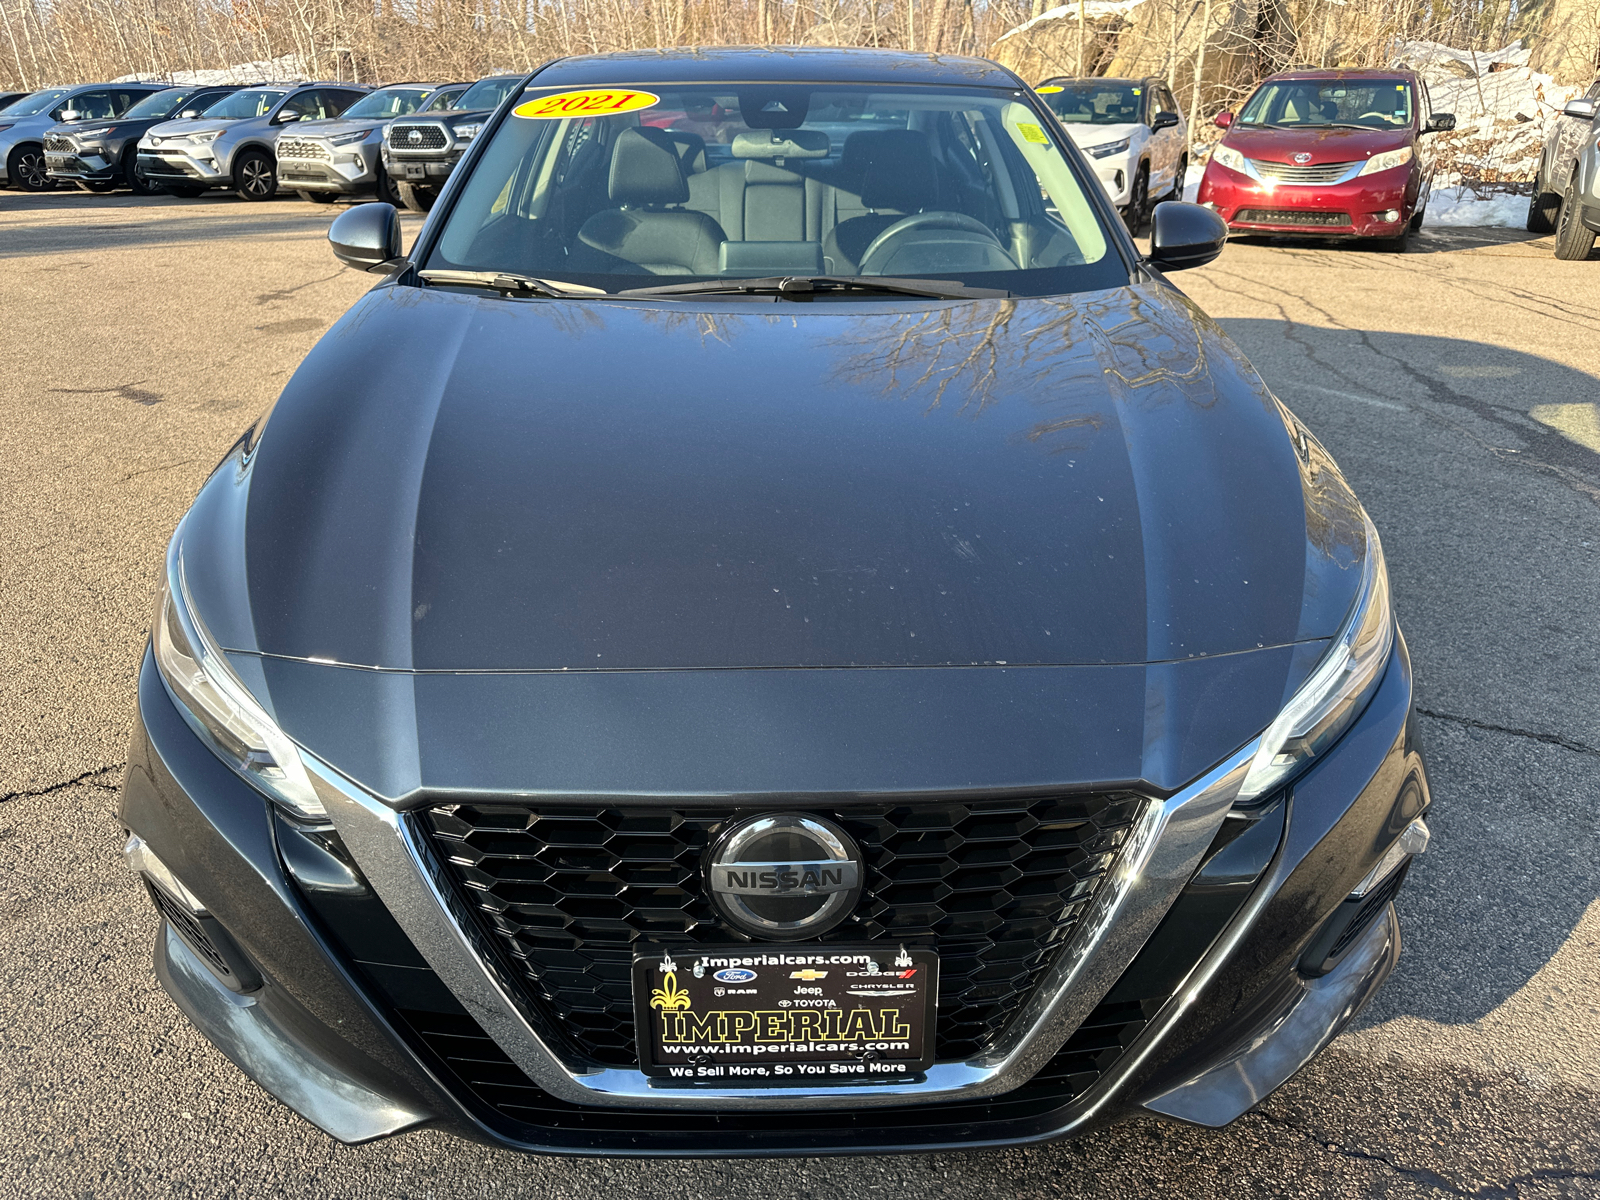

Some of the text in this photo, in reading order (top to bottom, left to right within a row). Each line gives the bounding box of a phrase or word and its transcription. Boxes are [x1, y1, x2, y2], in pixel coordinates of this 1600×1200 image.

[534, 94, 637, 115] 2021
[727, 868, 842, 888] NISSAN
[701, 954, 870, 968] Imperialcars.com
[793, 985, 823, 996] Jeep
[793, 999, 837, 1008] TOYOTA
[661, 1009, 910, 1042] IMPERIAL
[662, 1042, 909, 1055] www.imperialcars.com
[669, 1062, 906, 1077] We Sell More, So You Save More
